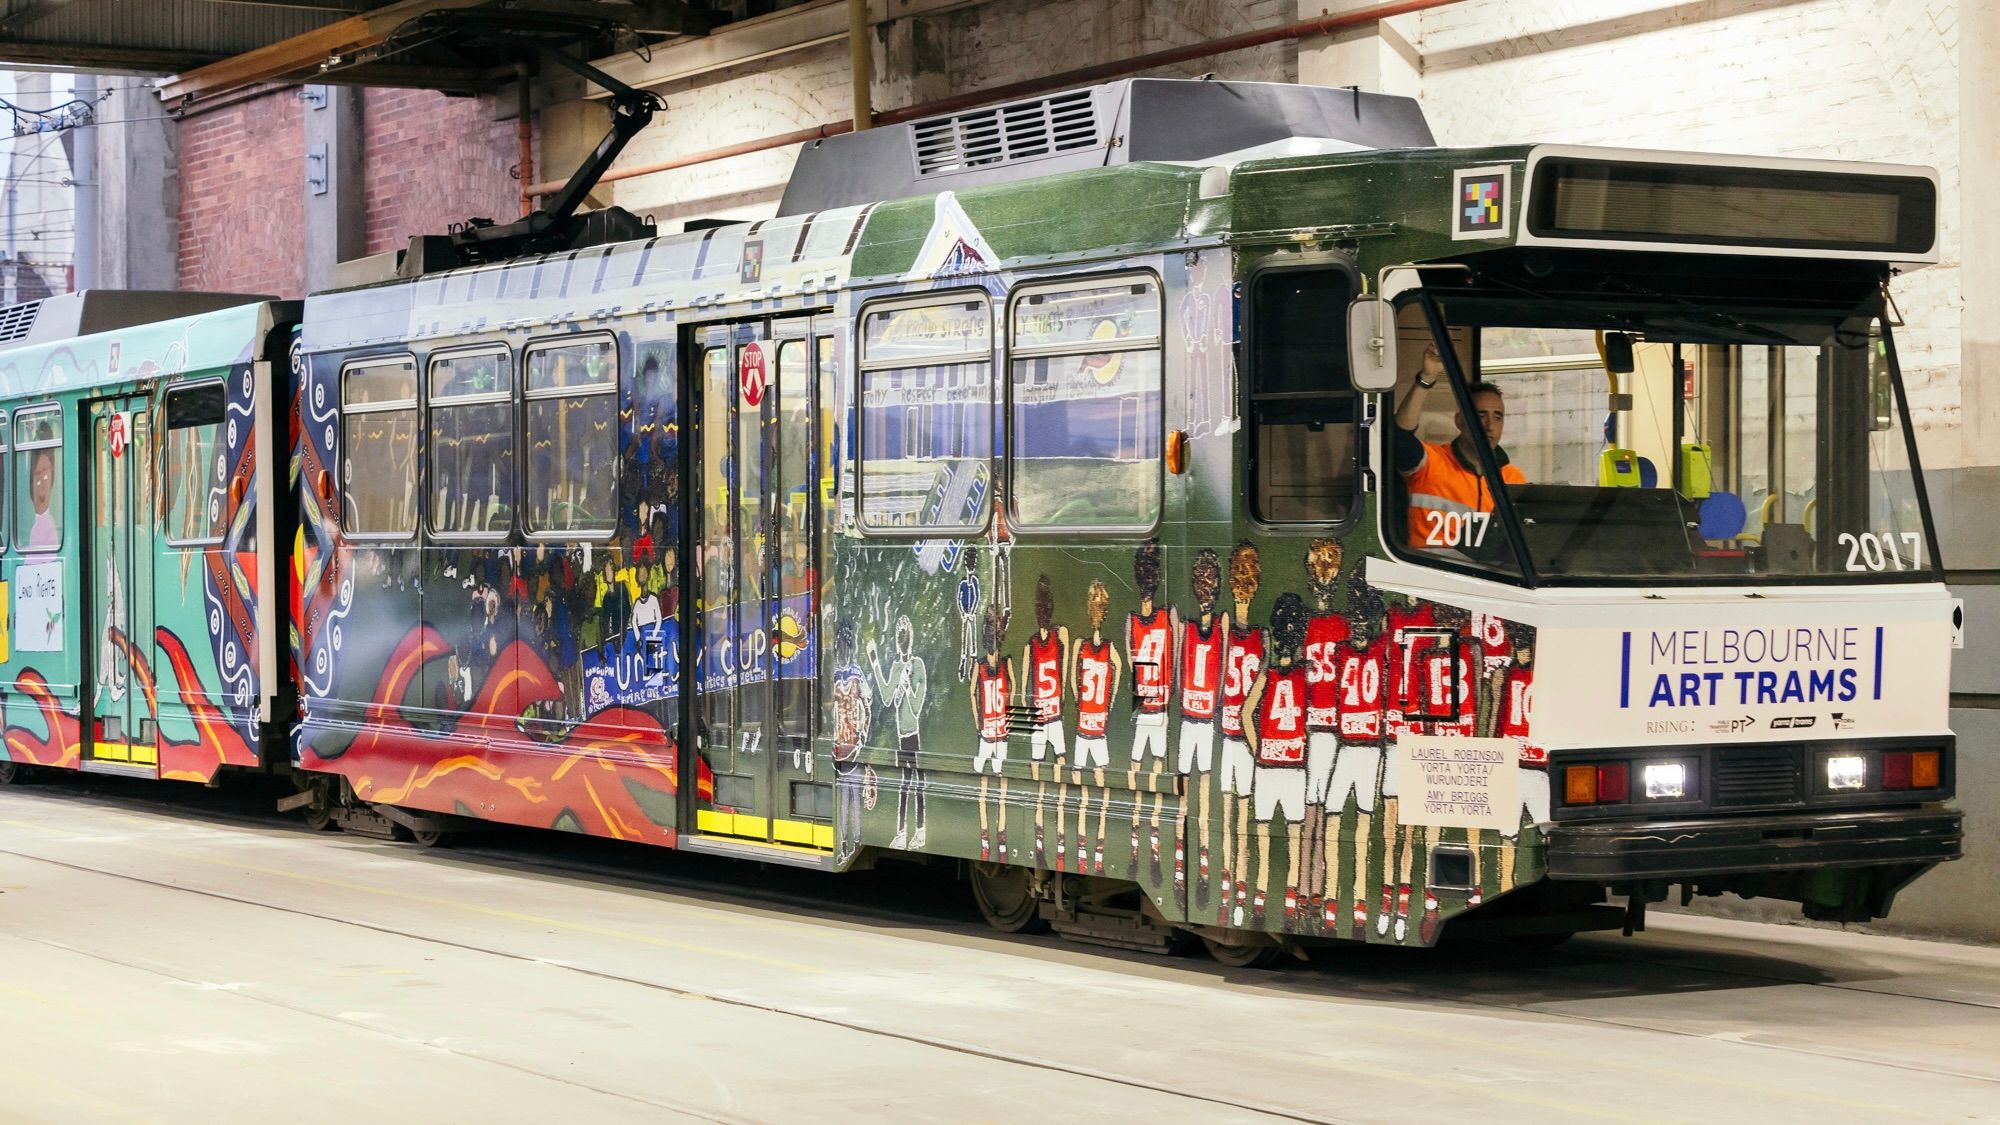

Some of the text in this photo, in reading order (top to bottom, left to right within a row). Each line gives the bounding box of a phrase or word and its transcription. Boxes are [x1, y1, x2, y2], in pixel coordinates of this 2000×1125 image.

[744, 351, 762, 368] STOP
[1426, 511, 1491, 547] 2017
[1838, 532, 1921, 572] 2017
[1650, 627, 1858, 665] MELBOURNE
[983, 678, 1005, 714] 16
[1038, 660, 1057, 698] 5
[1341, 658, 1379, 705] 40
[1648, 668, 1858, 707] ART TRAMS
[1269, 680, 1301, 731] 4
[1411, 748, 1504, 761] LAUREL ROBINSON
[1420, 762, 1494, 775] YORTA YORTA/
[1426, 774, 1488, 787] WURUNDJERI
[1427, 790, 1489, 803] AMY BRIGGS
[1424, 803, 1493, 816] YORTA YORTA
